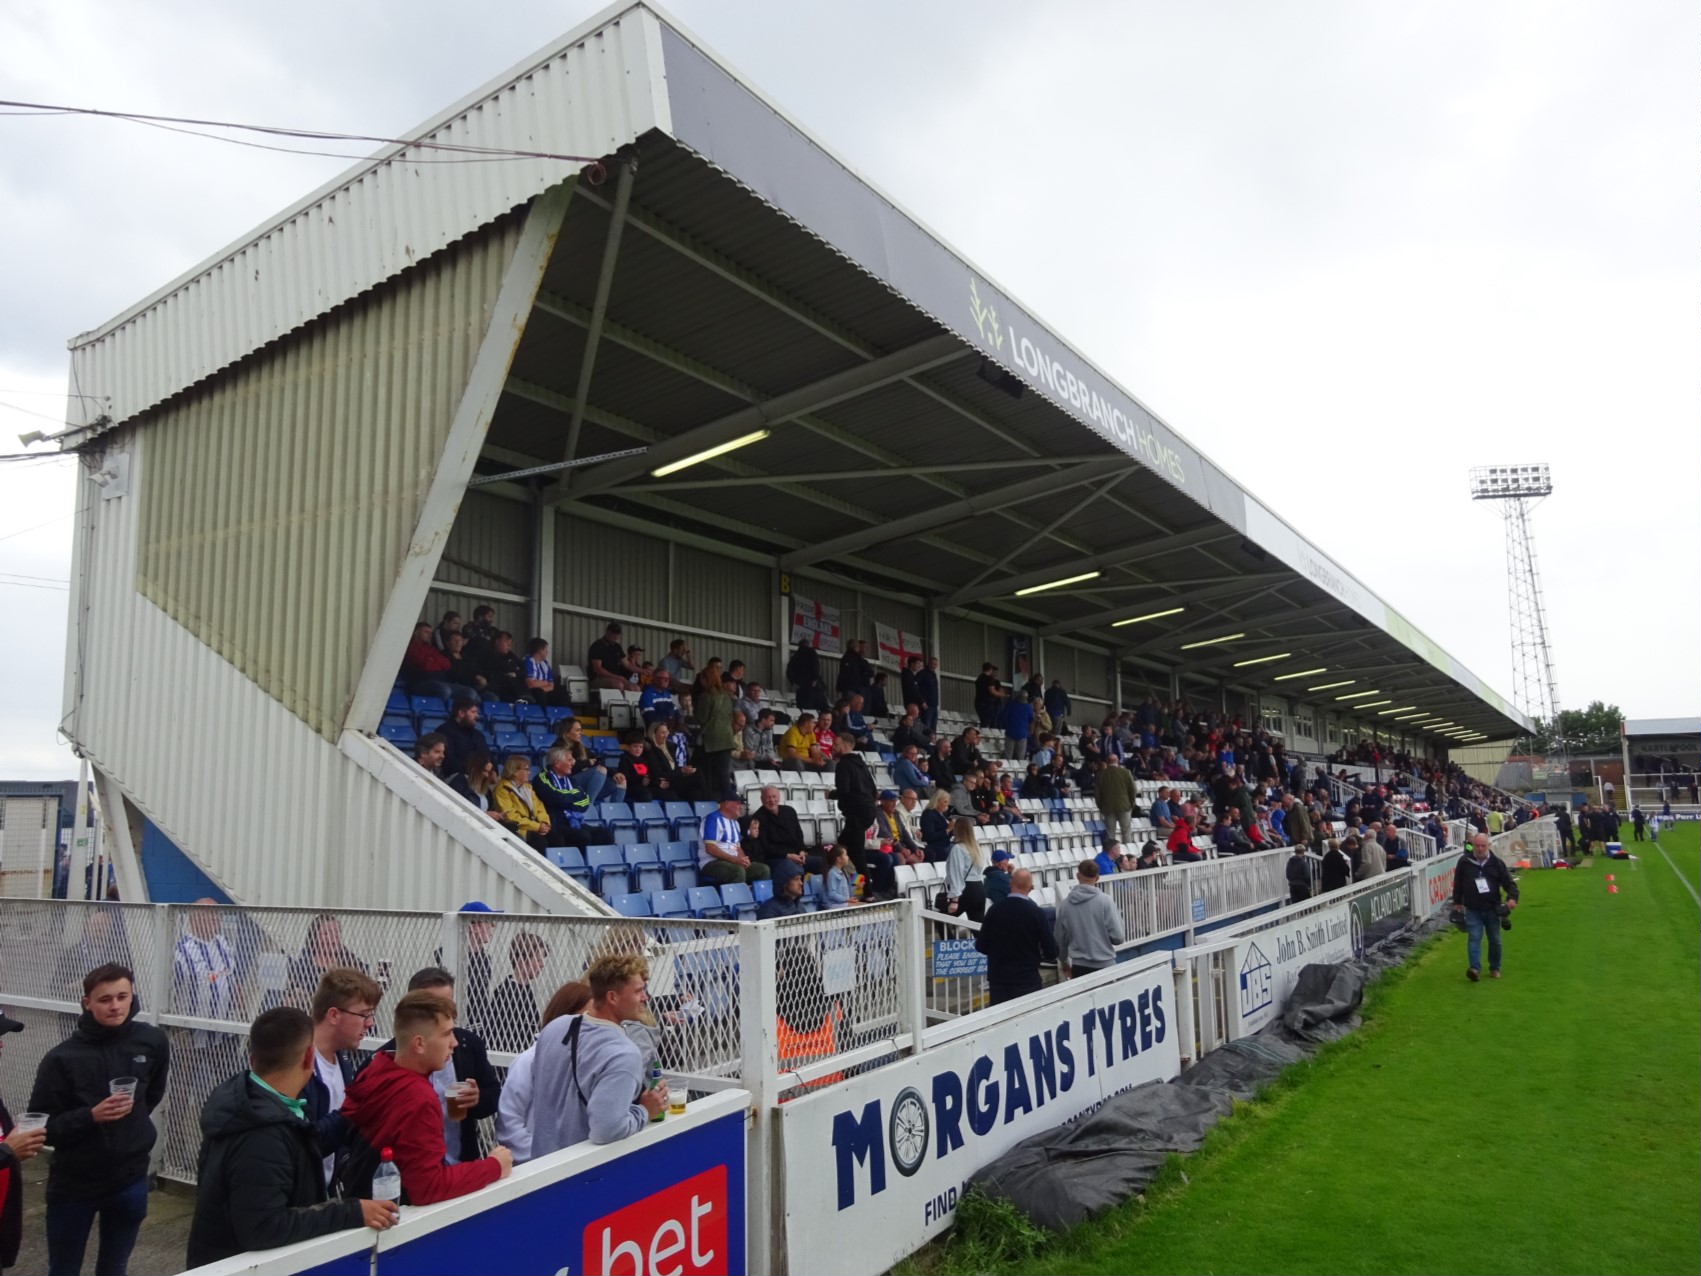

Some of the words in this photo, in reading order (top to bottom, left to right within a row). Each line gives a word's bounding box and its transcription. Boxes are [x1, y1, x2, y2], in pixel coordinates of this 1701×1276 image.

[1009, 326, 1137, 451] LONGBRANCH
[1136, 424, 1185, 483] HOMES
[939, 940, 976, 952] BLOCK
[1276, 937, 1296, 964] John
[1296, 930, 1306, 956] B.
[1306, 921, 1325, 953] Smith
[1327, 912, 1348, 943] Limited
[947, 966, 976, 974] CORRECT
[1082, 984, 1166, 1077] TYRES
[925, 1186, 957, 1227] FIND
[602, 1194, 714, 1276] bet
